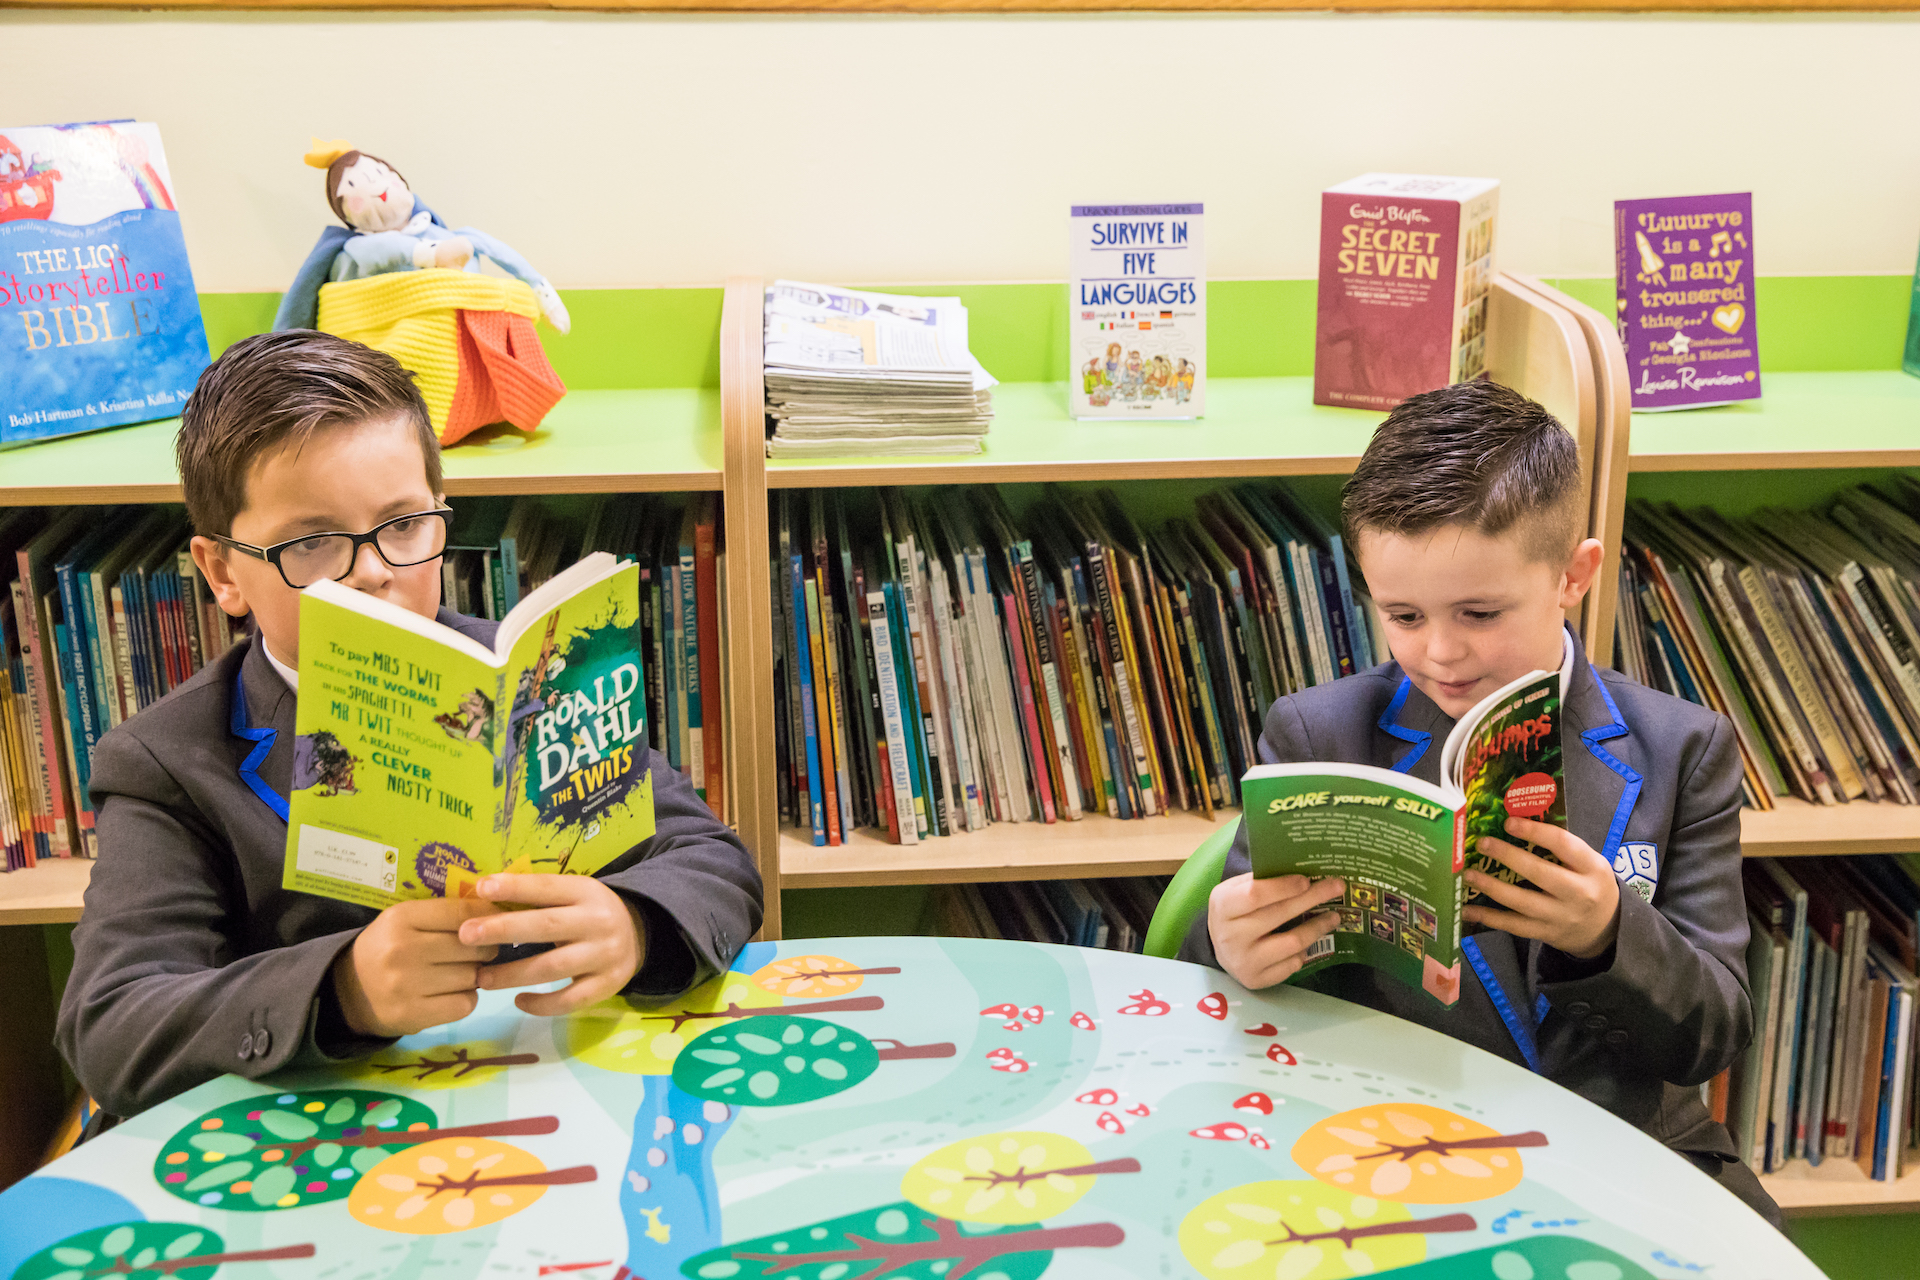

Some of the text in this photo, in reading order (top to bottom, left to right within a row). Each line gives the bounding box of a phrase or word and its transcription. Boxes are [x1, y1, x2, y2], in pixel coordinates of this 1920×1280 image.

[1349, 203, 1431, 225] Enid Blyton
[1091, 221, 1187, 245] SURVIVE IN
[1341, 224, 1441, 255] SECRET
[1662, 237, 1701, 254] is a
[16, 248, 71, 275] THE
[1124, 252, 1155, 275] FIVE
[1337, 249, 1439, 280] SEVEN
[1670, 259, 1743, 284] many
[0, 257, 165, 310] Storyteller
[1081, 282, 1196, 305] LANGUAGES
[1639, 282, 1746, 308] trousered
[18, 298, 161, 351] BIBLE
[1651, 353, 1696, 366] Georgia
[1635, 366, 1745, 394] Louise Rennison
[8, 412, 32, 427] Bob
[34, 408, 84, 423] Hartman
[85, 403, 98, 416] &
[899, 558, 909, 573] READ
[903, 585, 914, 604] ABOUT
[1023, 562, 1051, 662] EYEWITNESS GUIDES
[1092, 562, 1123, 660] EYEWITNESS GUIDES
[682, 574, 700, 693] HOW NATURE WORKS
[874, 625, 888, 646] BIRD
[73, 652, 83, 673] FIRST
[113, 621, 137, 701] ELECTRICITY
[330, 641, 442, 691] To pay MRS TWIT
[314, 660, 334, 673] BACK
[355, 669, 378, 686] THE
[384, 679, 438, 707] WORMS
[323, 682, 331, 691] IN
[877, 651, 898, 718] IDENTIFICATION
[24, 664, 43, 736] ELECTRICITY
[37, 742, 45, 757] and
[76, 674, 92, 731] ENCYCLOPEDIA
[535, 662, 639, 752] ROALD
[85, 733, 94, 744] OF
[331, 700, 463, 758] MR TWIT THOUGHT UP
[888, 721, 900, 738] AND
[360, 734, 410, 756] A REALLY
[537, 700, 643, 791] DAHL
[372, 752, 432, 781] CLEVER
[890, 742, 907, 792] FIELDCRAFT
[387, 774, 473, 820] NASTY TRICK
[551, 786, 573, 807] THE
[582, 784, 622, 813] Quentin Blake
[1507, 784, 1556, 798] GOOSEBUMPS
[1267, 791, 1443, 820] SCARE yourself SILLY
[426, 845, 470, 868] ROALD
[1639, 849, 1651, 869] S
[424, 869, 446, 883] NUMB
[1358, 876, 1398, 892] CREEPY
